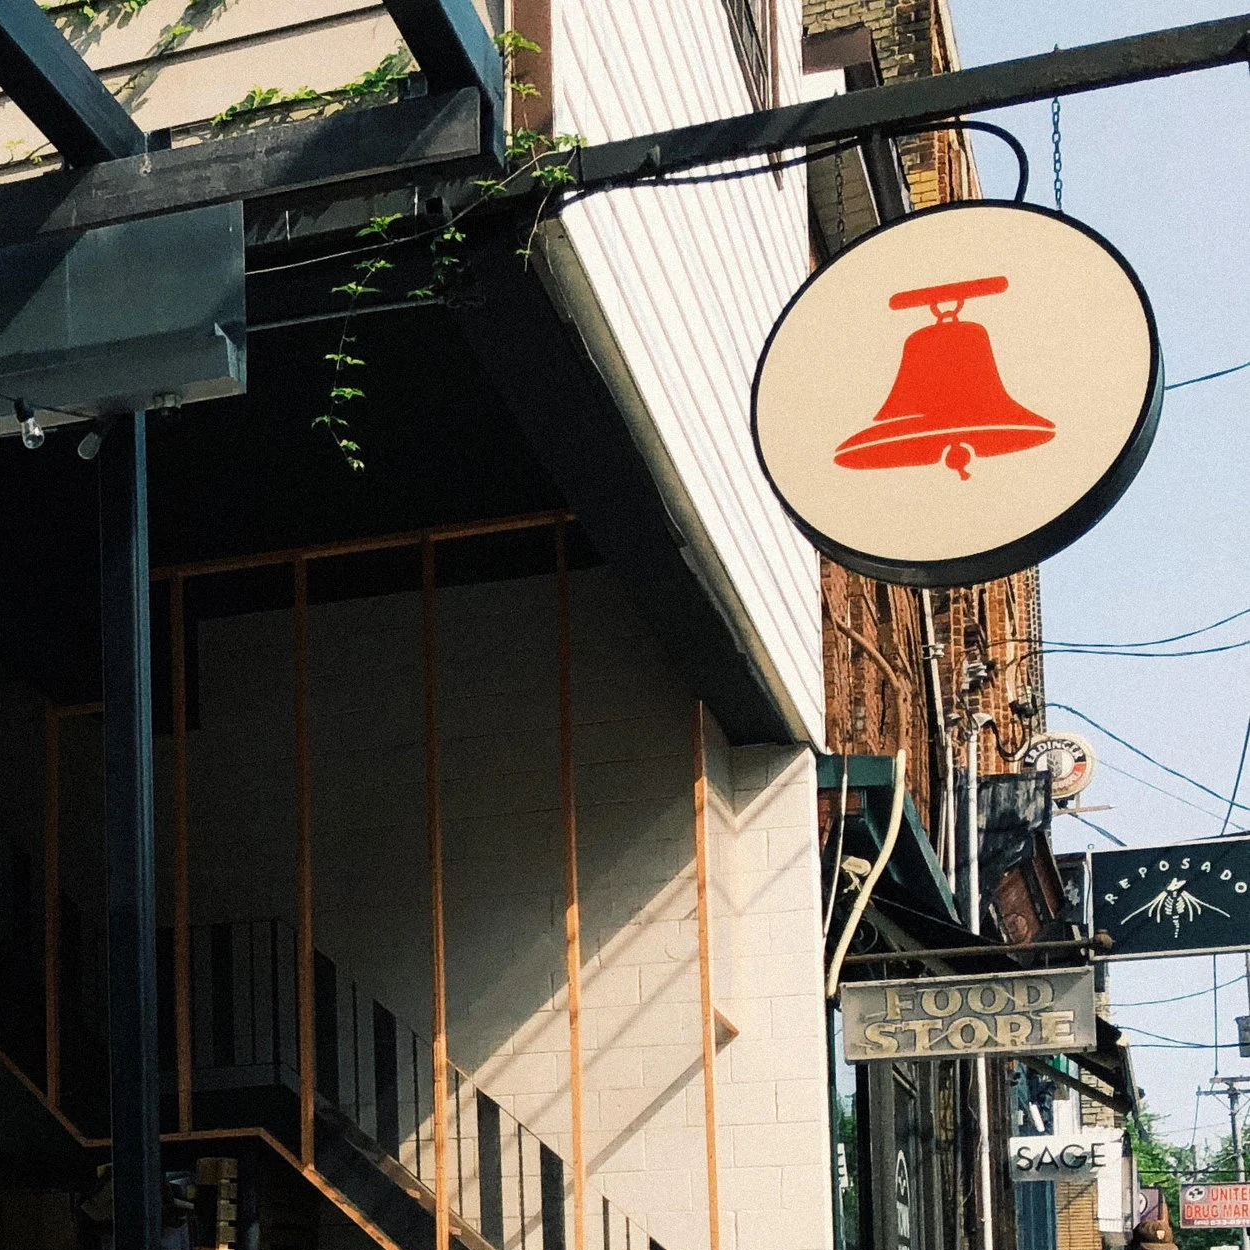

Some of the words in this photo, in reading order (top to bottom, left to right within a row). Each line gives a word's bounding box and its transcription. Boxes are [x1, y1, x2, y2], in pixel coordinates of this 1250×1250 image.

[1025, 740, 1084, 763] ERDINGER
[1105, 858, 1248, 904] REPOSADO
[883, 979, 1054, 1021] FOOD
[864, 1010, 1076, 1055] STORE
[1016, 1142, 1106, 1172] SAGE
[1211, 1187, 1250, 1202] UNITE
[1186, 1204, 1218, 1219] DRUG
